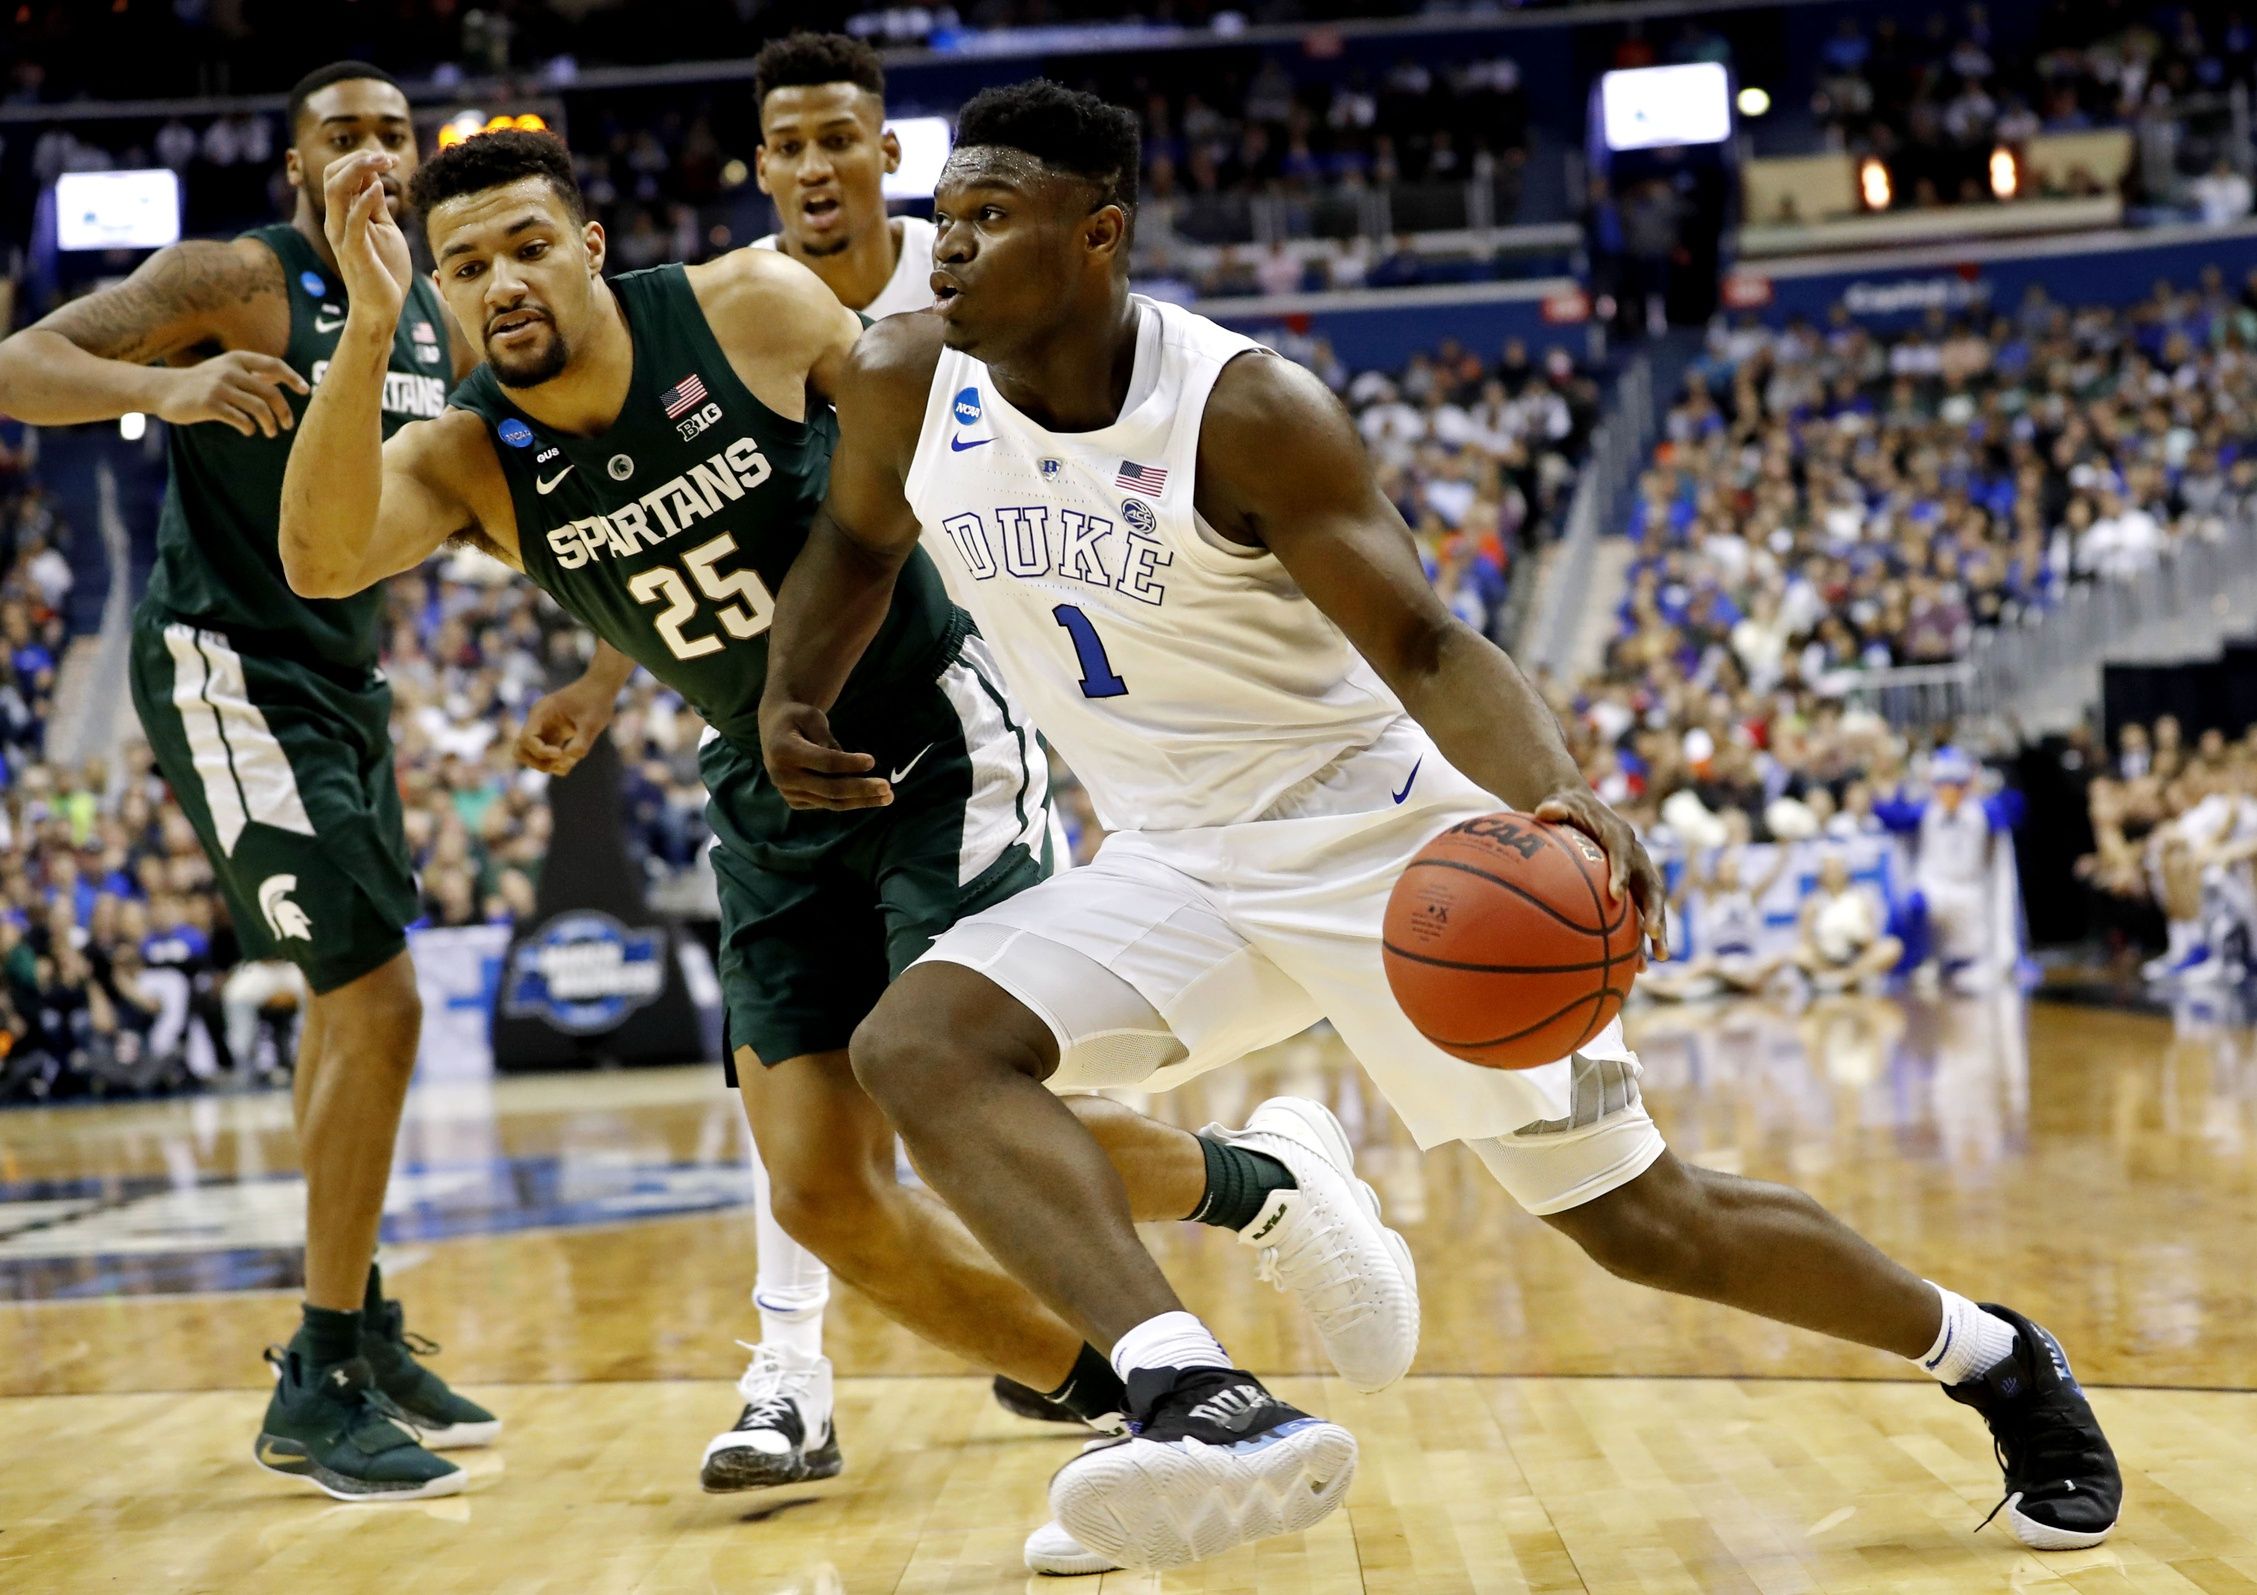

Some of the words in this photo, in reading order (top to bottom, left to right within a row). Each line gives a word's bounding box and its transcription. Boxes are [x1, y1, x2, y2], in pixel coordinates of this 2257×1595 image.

[536, 447, 560, 463] GUS
[956, 401, 980, 418] NCAA
[547, 437, 772, 569] SPARTANS
[1126, 509, 1153, 525] ACC
[627, 531, 776, 661] 25
[942, 506, 1174, 606] DUKE
[1052, 603, 1129, 698] 1
